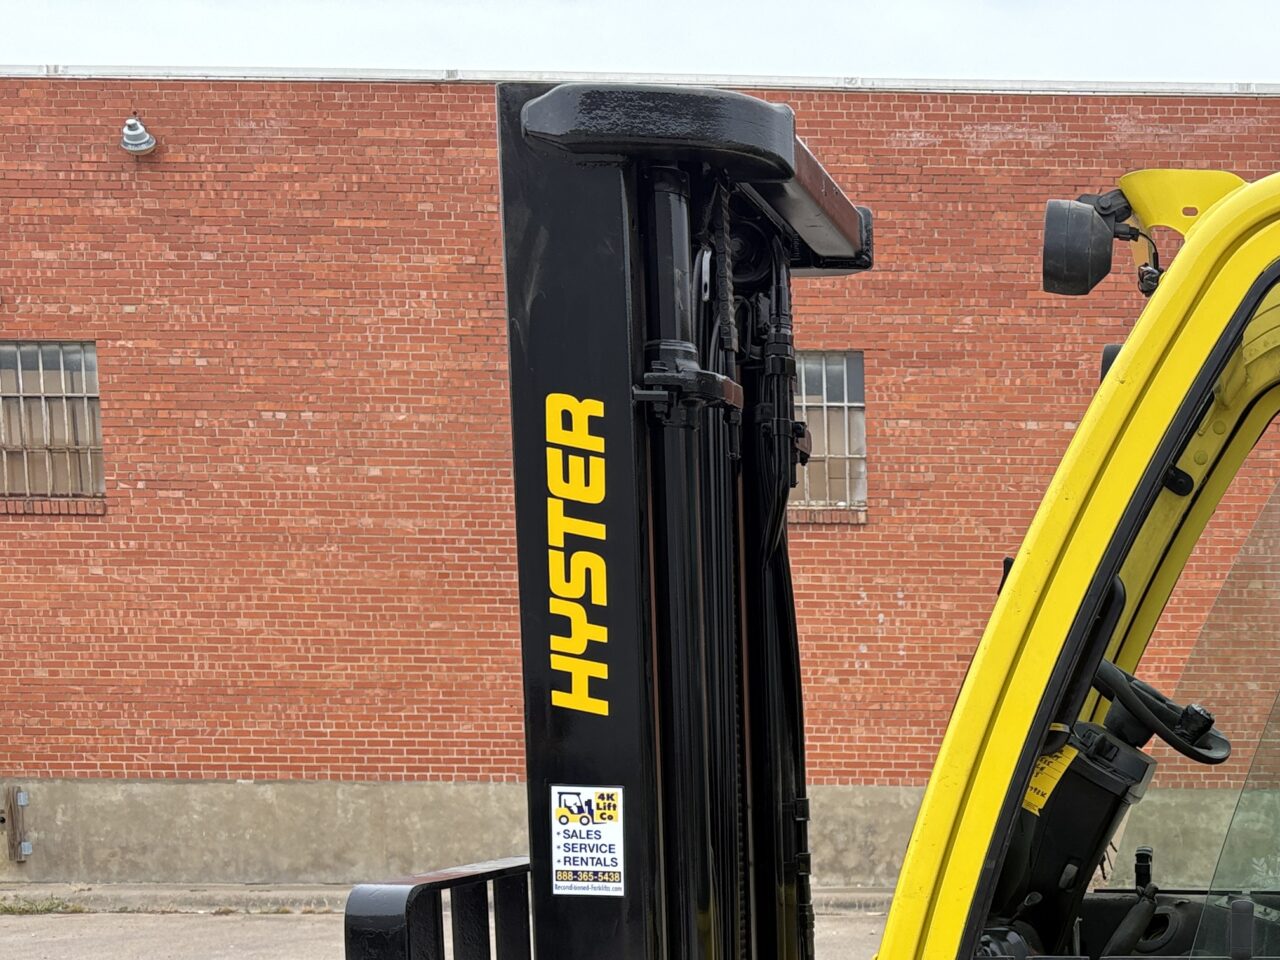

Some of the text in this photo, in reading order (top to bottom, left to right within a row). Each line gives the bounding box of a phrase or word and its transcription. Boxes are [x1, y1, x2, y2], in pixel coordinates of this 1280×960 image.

[545, 392, 609, 716] HYSTER
[597, 793, 615, 801] 4K
[596, 802, 617, 811] Lift
[599, 812, 614, 821] Co
[563, 829, 602, 840] SALES
[563, 843, 616, 854] SERVICE
[563, 856, 618, 868] RENTALS
[556, 871, 620, 881] 888-365-5438
